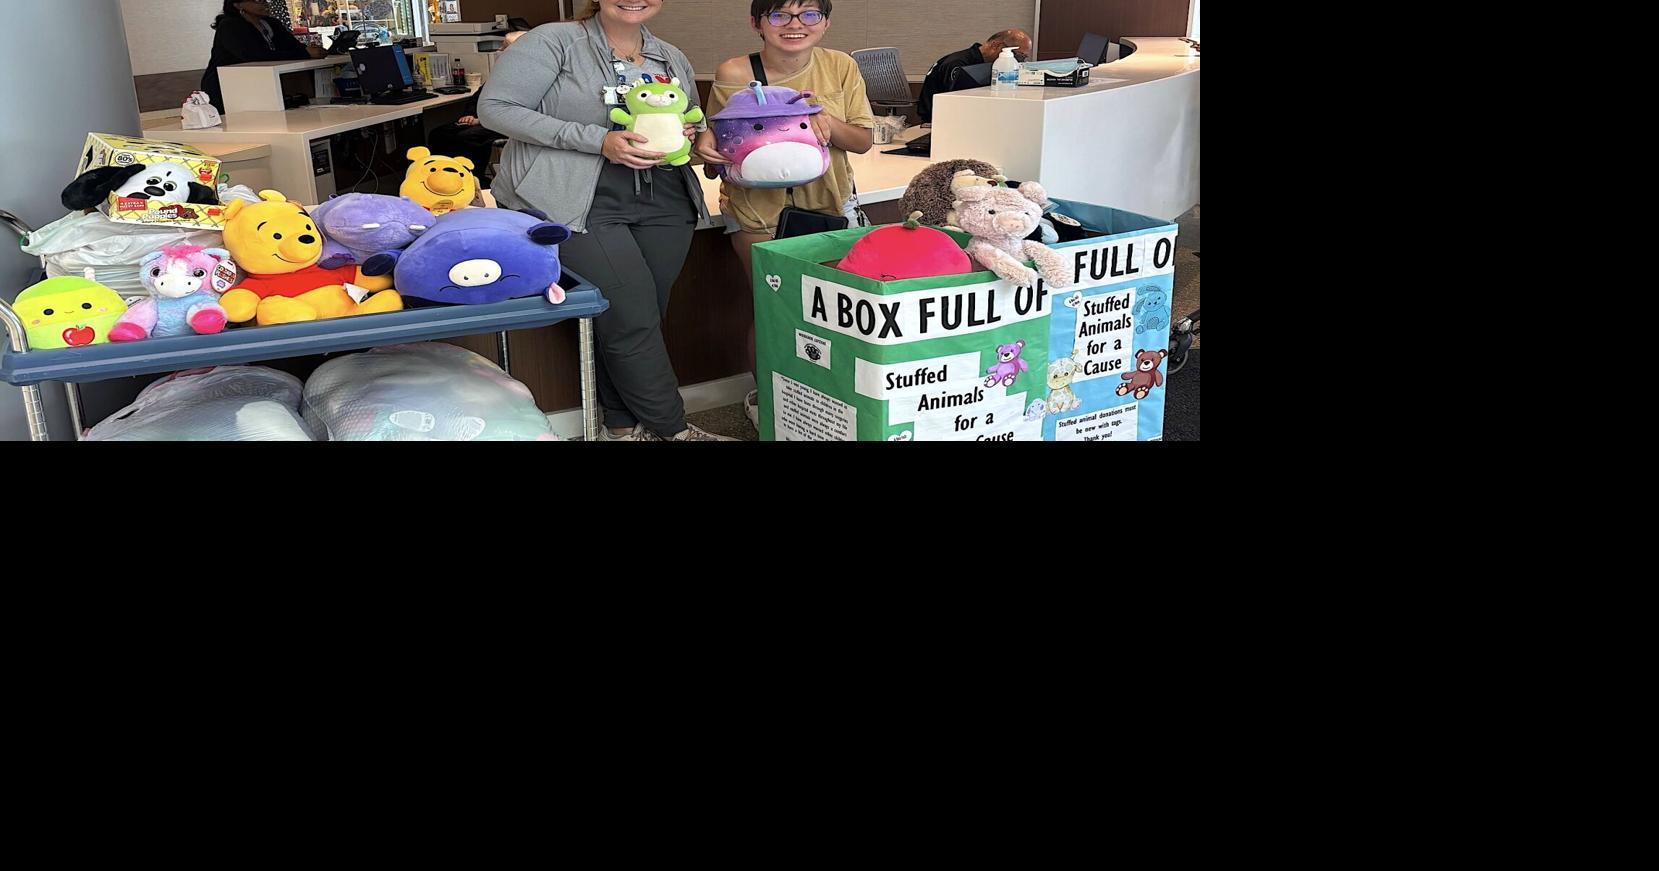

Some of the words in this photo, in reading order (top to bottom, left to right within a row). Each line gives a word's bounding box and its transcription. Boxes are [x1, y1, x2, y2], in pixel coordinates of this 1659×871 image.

[1074, 243, 1139, 284] FULL
[1153, 235, 1177, 269] O
[811, 286, 828, 322] A
[837, 292, 904, 339] BOX
[919, 289, 1001, 334] FULL
[1084, 293, 1130, 317] Stuffed
[1078, 314, 1131, 338] Animals
[1087, 340, 1107, 356] for
[1114, 339, 1122, 350] a
[886, 365, 947, 390] Stuffed
[1084, 359, 1122, 375] Cause
[918, 386, 984, 411] Animals
[954, 415, 978, 432] for
[986, 412, 994, 424] a
[1059, 419, 1077, 428] Stuffed
[1080, 414, 1096, 423] animal
[1099, 408, 1122, 419] donations
[1102, 431, 1112, 440] you!
